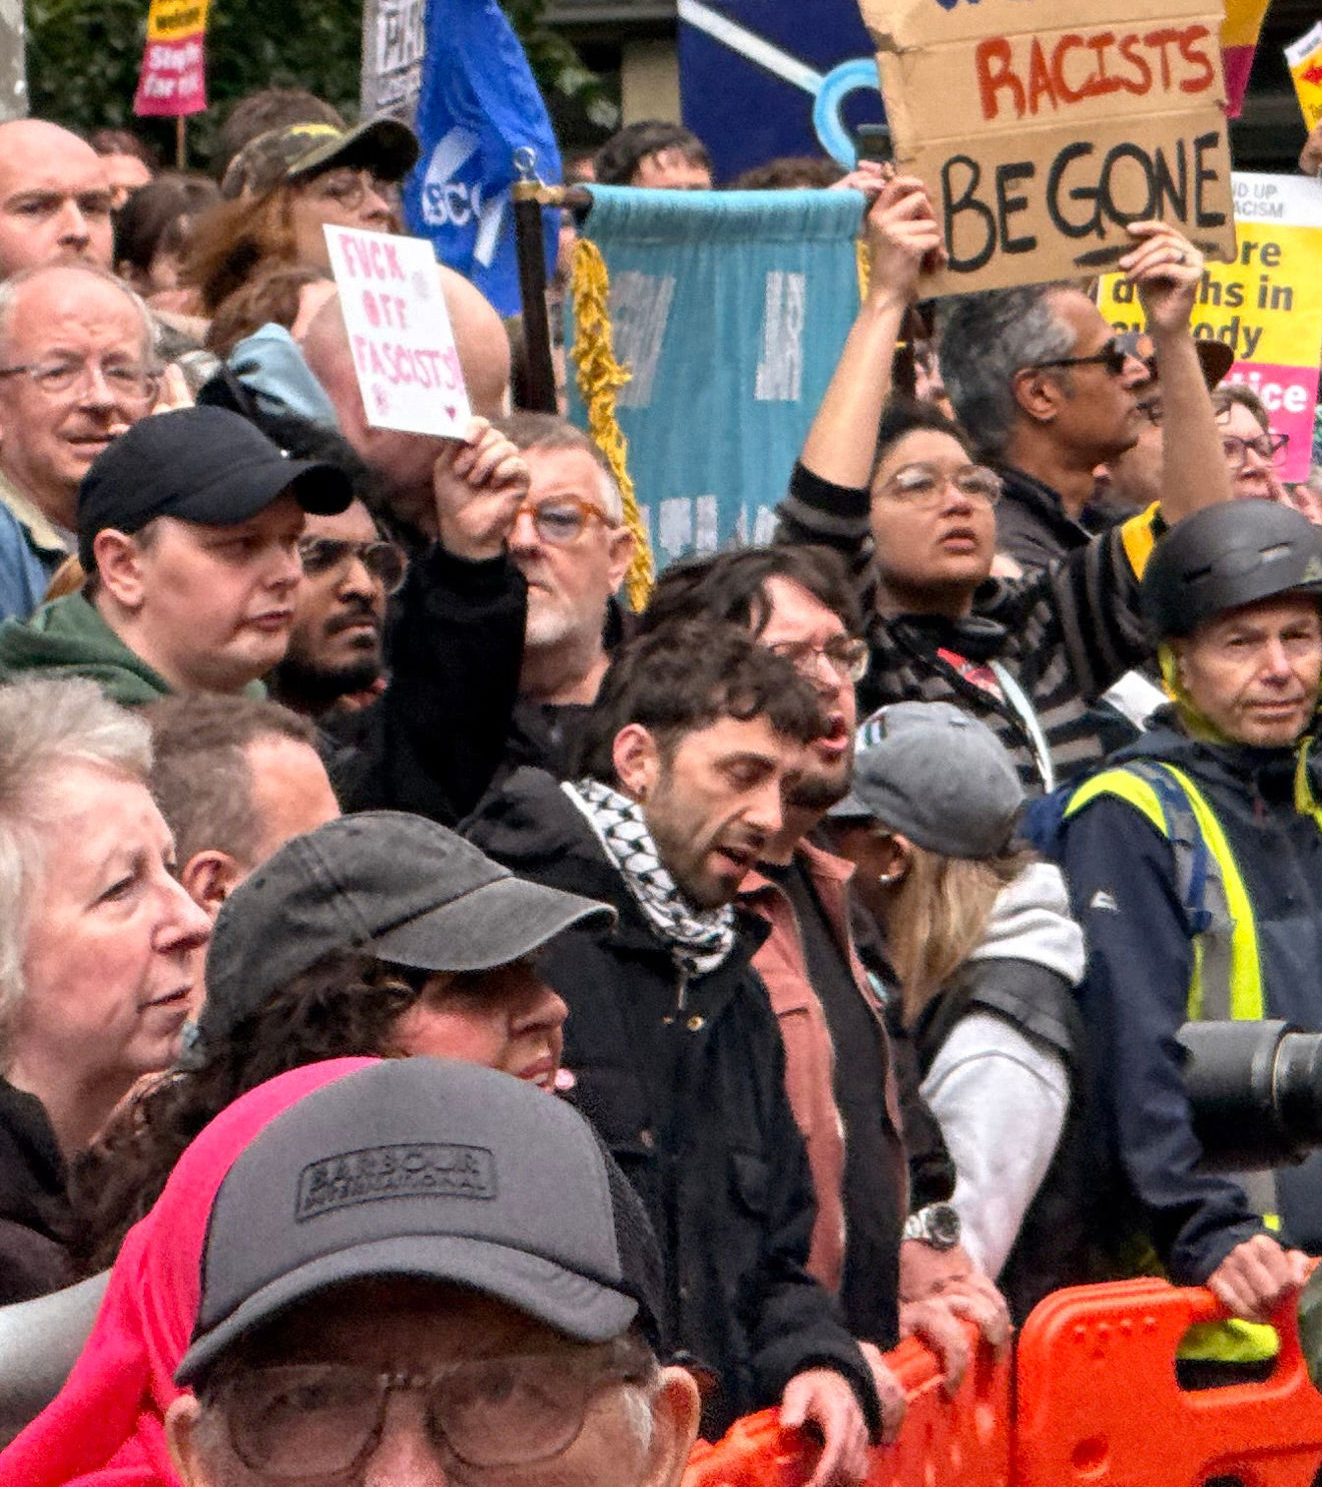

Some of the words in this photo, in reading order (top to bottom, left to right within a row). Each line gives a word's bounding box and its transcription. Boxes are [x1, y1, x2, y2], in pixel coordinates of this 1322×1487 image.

[974, 25, 1216, 120] RACISTS
[1253, 182, 1278, 198] UP
[337, 233, 405, 281] FUCK
[1241, 240, 1282, 267] re
[361, 289, 409, 331] OFF
[1257, 273, 1294, 312] in
